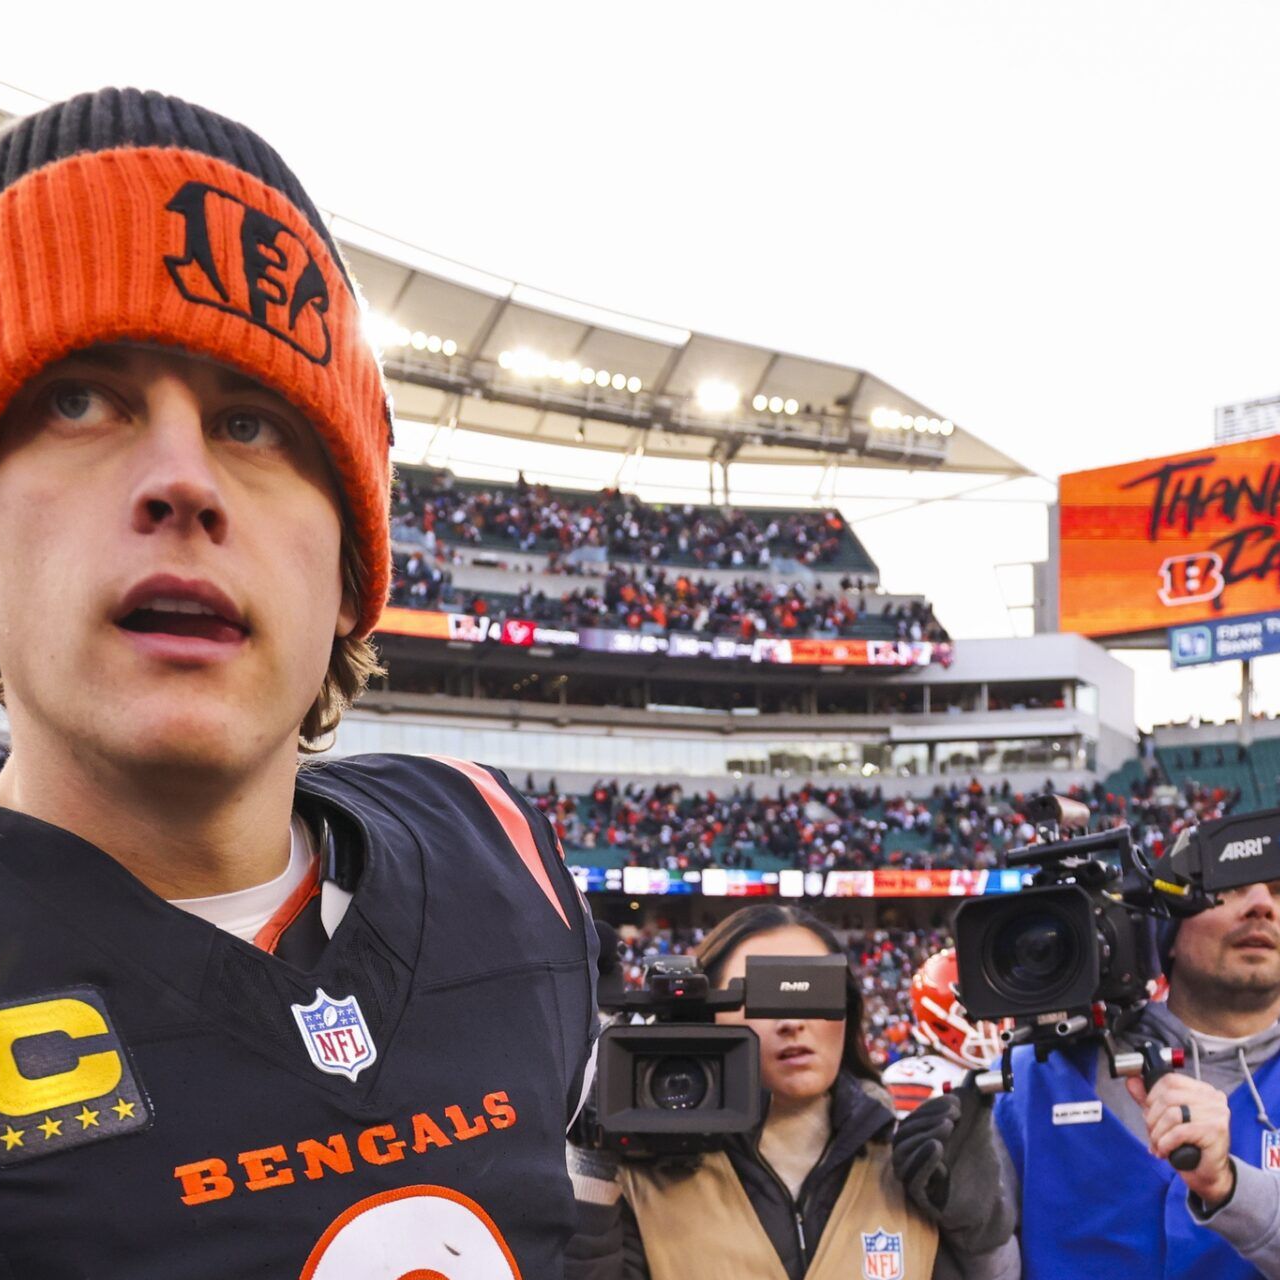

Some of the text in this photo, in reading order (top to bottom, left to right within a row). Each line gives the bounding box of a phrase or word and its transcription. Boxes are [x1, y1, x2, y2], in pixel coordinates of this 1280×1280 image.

[1216, 637, 1263, 656] BANK
[315, 1028, 366, 1063] NFL
[173, 1090, 517, 1206] BENGALS
[866, 1253, 898, 1279] NFL
